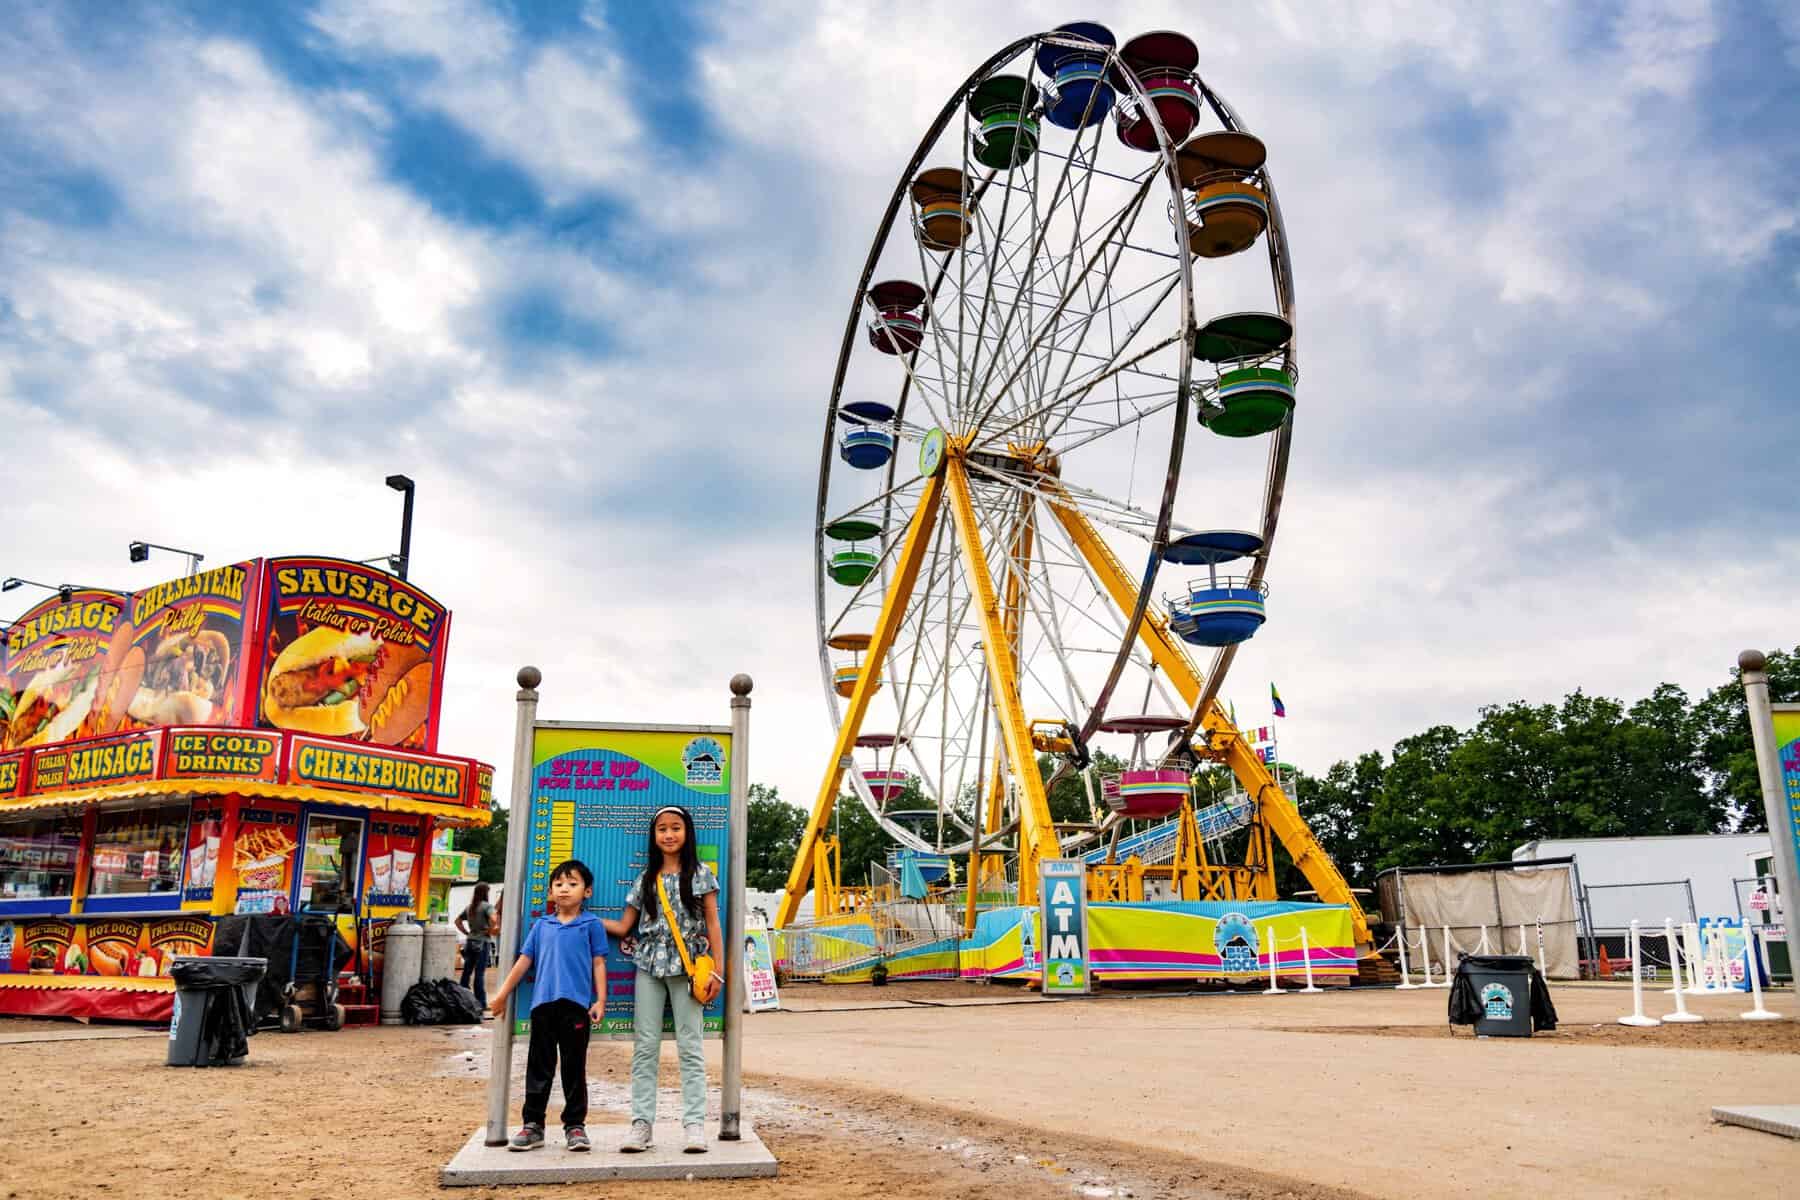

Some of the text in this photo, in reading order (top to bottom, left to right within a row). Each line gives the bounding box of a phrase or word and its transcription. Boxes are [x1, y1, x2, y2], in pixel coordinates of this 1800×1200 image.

[133, 565, 246, 627] CHEESESTEAK
[277, 568, 436, 632] SAUSAGE
[8, 602, 121, 658] SAUSAGE
[160, 602, 207, 637] Philly
[301, 598, 416, 645] Italian or Polish
[175, 735, 272, 754] ICE COLD
[68, 739, 153, 782] SAUSAGE
[178, 755, 262, 773] DRINKS
[300, 747, 459, 796] CHEESEBURGER
[552, 759, 641, 777] SIZE UP
[0, 763, 17, 788] ES
[36, 771, 64, 787] POLISH
[538, 777, 650, 791] FOR SAFE FUN
[1051, 863, 1074, 873] ATM
[89, 923, 138, 938] HOT DOGS
[184, 921, 209, 938] FRIES
[1050, 880, 1082, 960] ATM
[1222, 959, 1259, 971] ROCK
